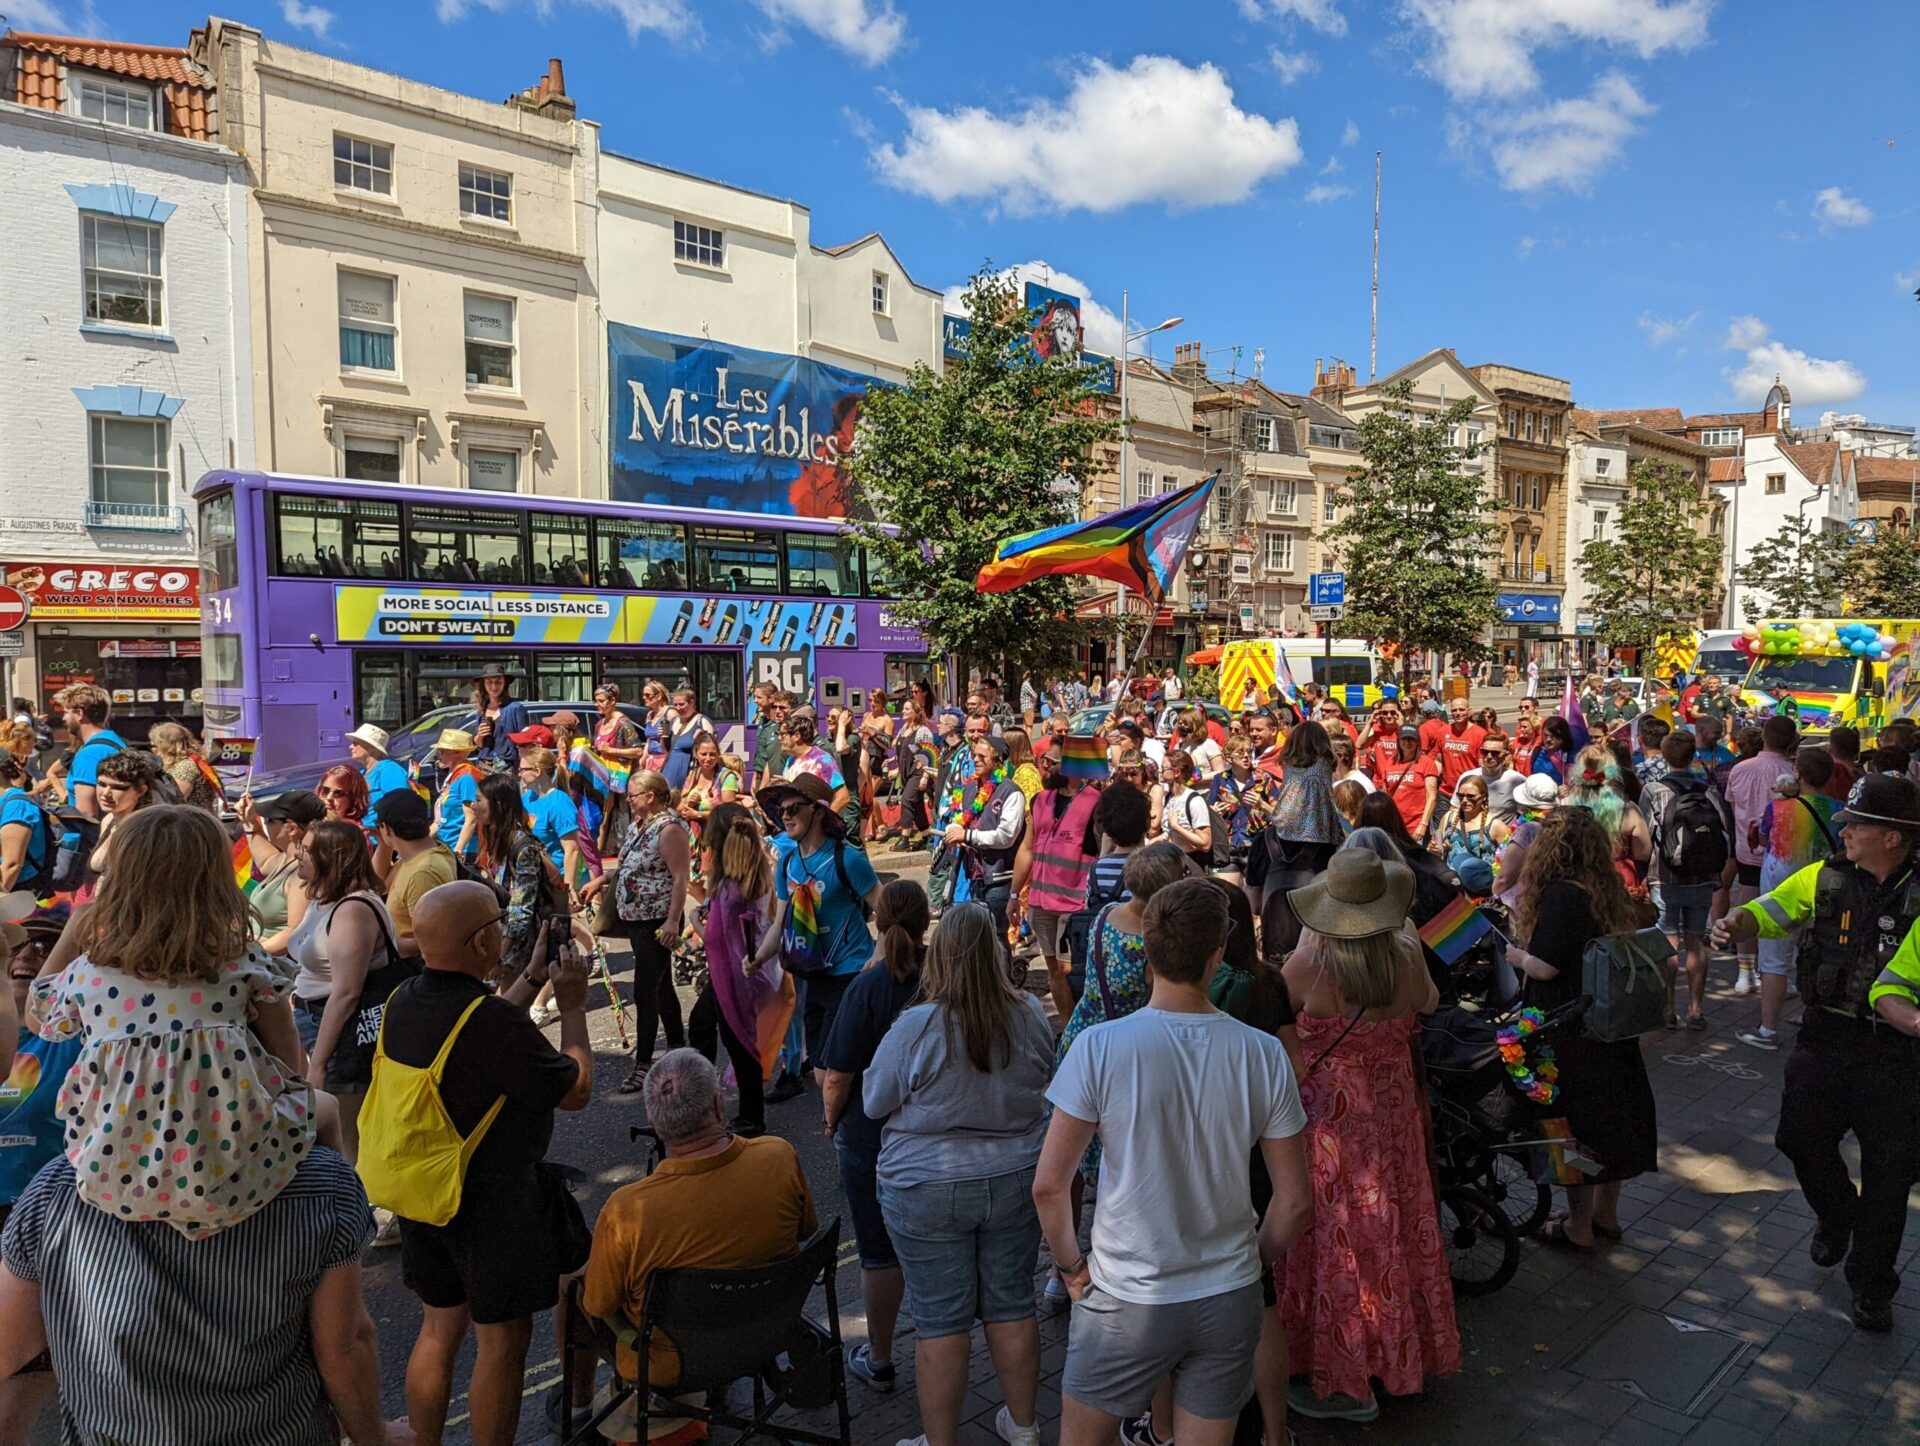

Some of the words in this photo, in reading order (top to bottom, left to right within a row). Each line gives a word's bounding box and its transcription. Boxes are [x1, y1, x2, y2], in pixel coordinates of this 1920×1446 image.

[715, 366, 769, 415] Les
[627, 379, 840, 466] Misérables
[10, 519, 50, 530] AUGUSTINES
[53, 522, 77, 532] PARADE
[50, 569, 190, 592] GRECO
[45, 594, 92, 604] WRAP
[95, 595, 194, 605] SANDWICHES
[383, 598, 431, 610] MORE
[434, 599, 494, 612] SOCIAL.
[497, 601, 533, 613] LESS
[535, 602, 608, 615] DISTANCE.
[385, 620, 436, 633] DON'T
[437, 621, 491, 634] SWEAT
[493, 623, 511, 634] IT.
[48, 660, 80, 672] open
[1444, 742, 1469, 752] PRIDE
